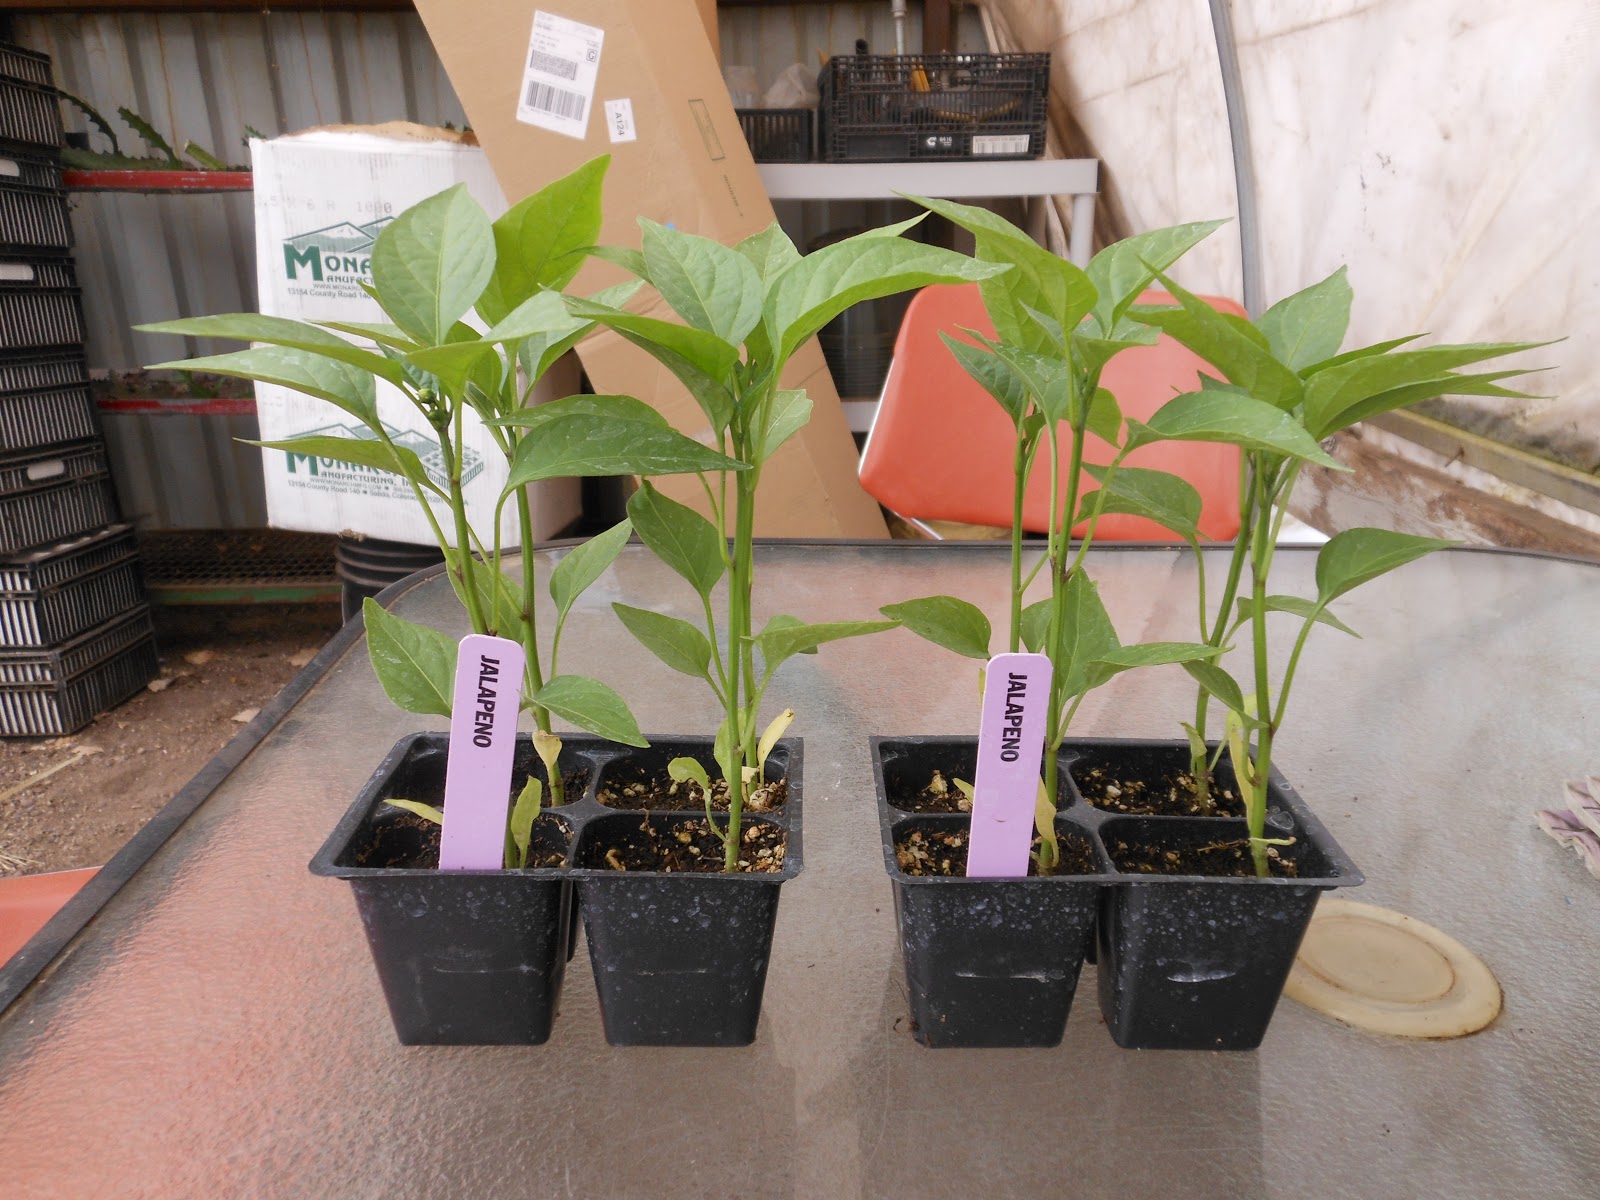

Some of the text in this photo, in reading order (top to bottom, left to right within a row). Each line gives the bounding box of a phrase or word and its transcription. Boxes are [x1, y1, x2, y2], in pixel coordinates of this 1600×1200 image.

[615, 112, 624, 135] A124
[310, 288, 336, 299] County
[338, 290, 357, 298] Road
[307, 482, 330, 492] County
[331, 485, 348, 493] Road
[473, 654, 500, 749] JALAPENO
[1000, 672, 1028, 763] JALAPENO
